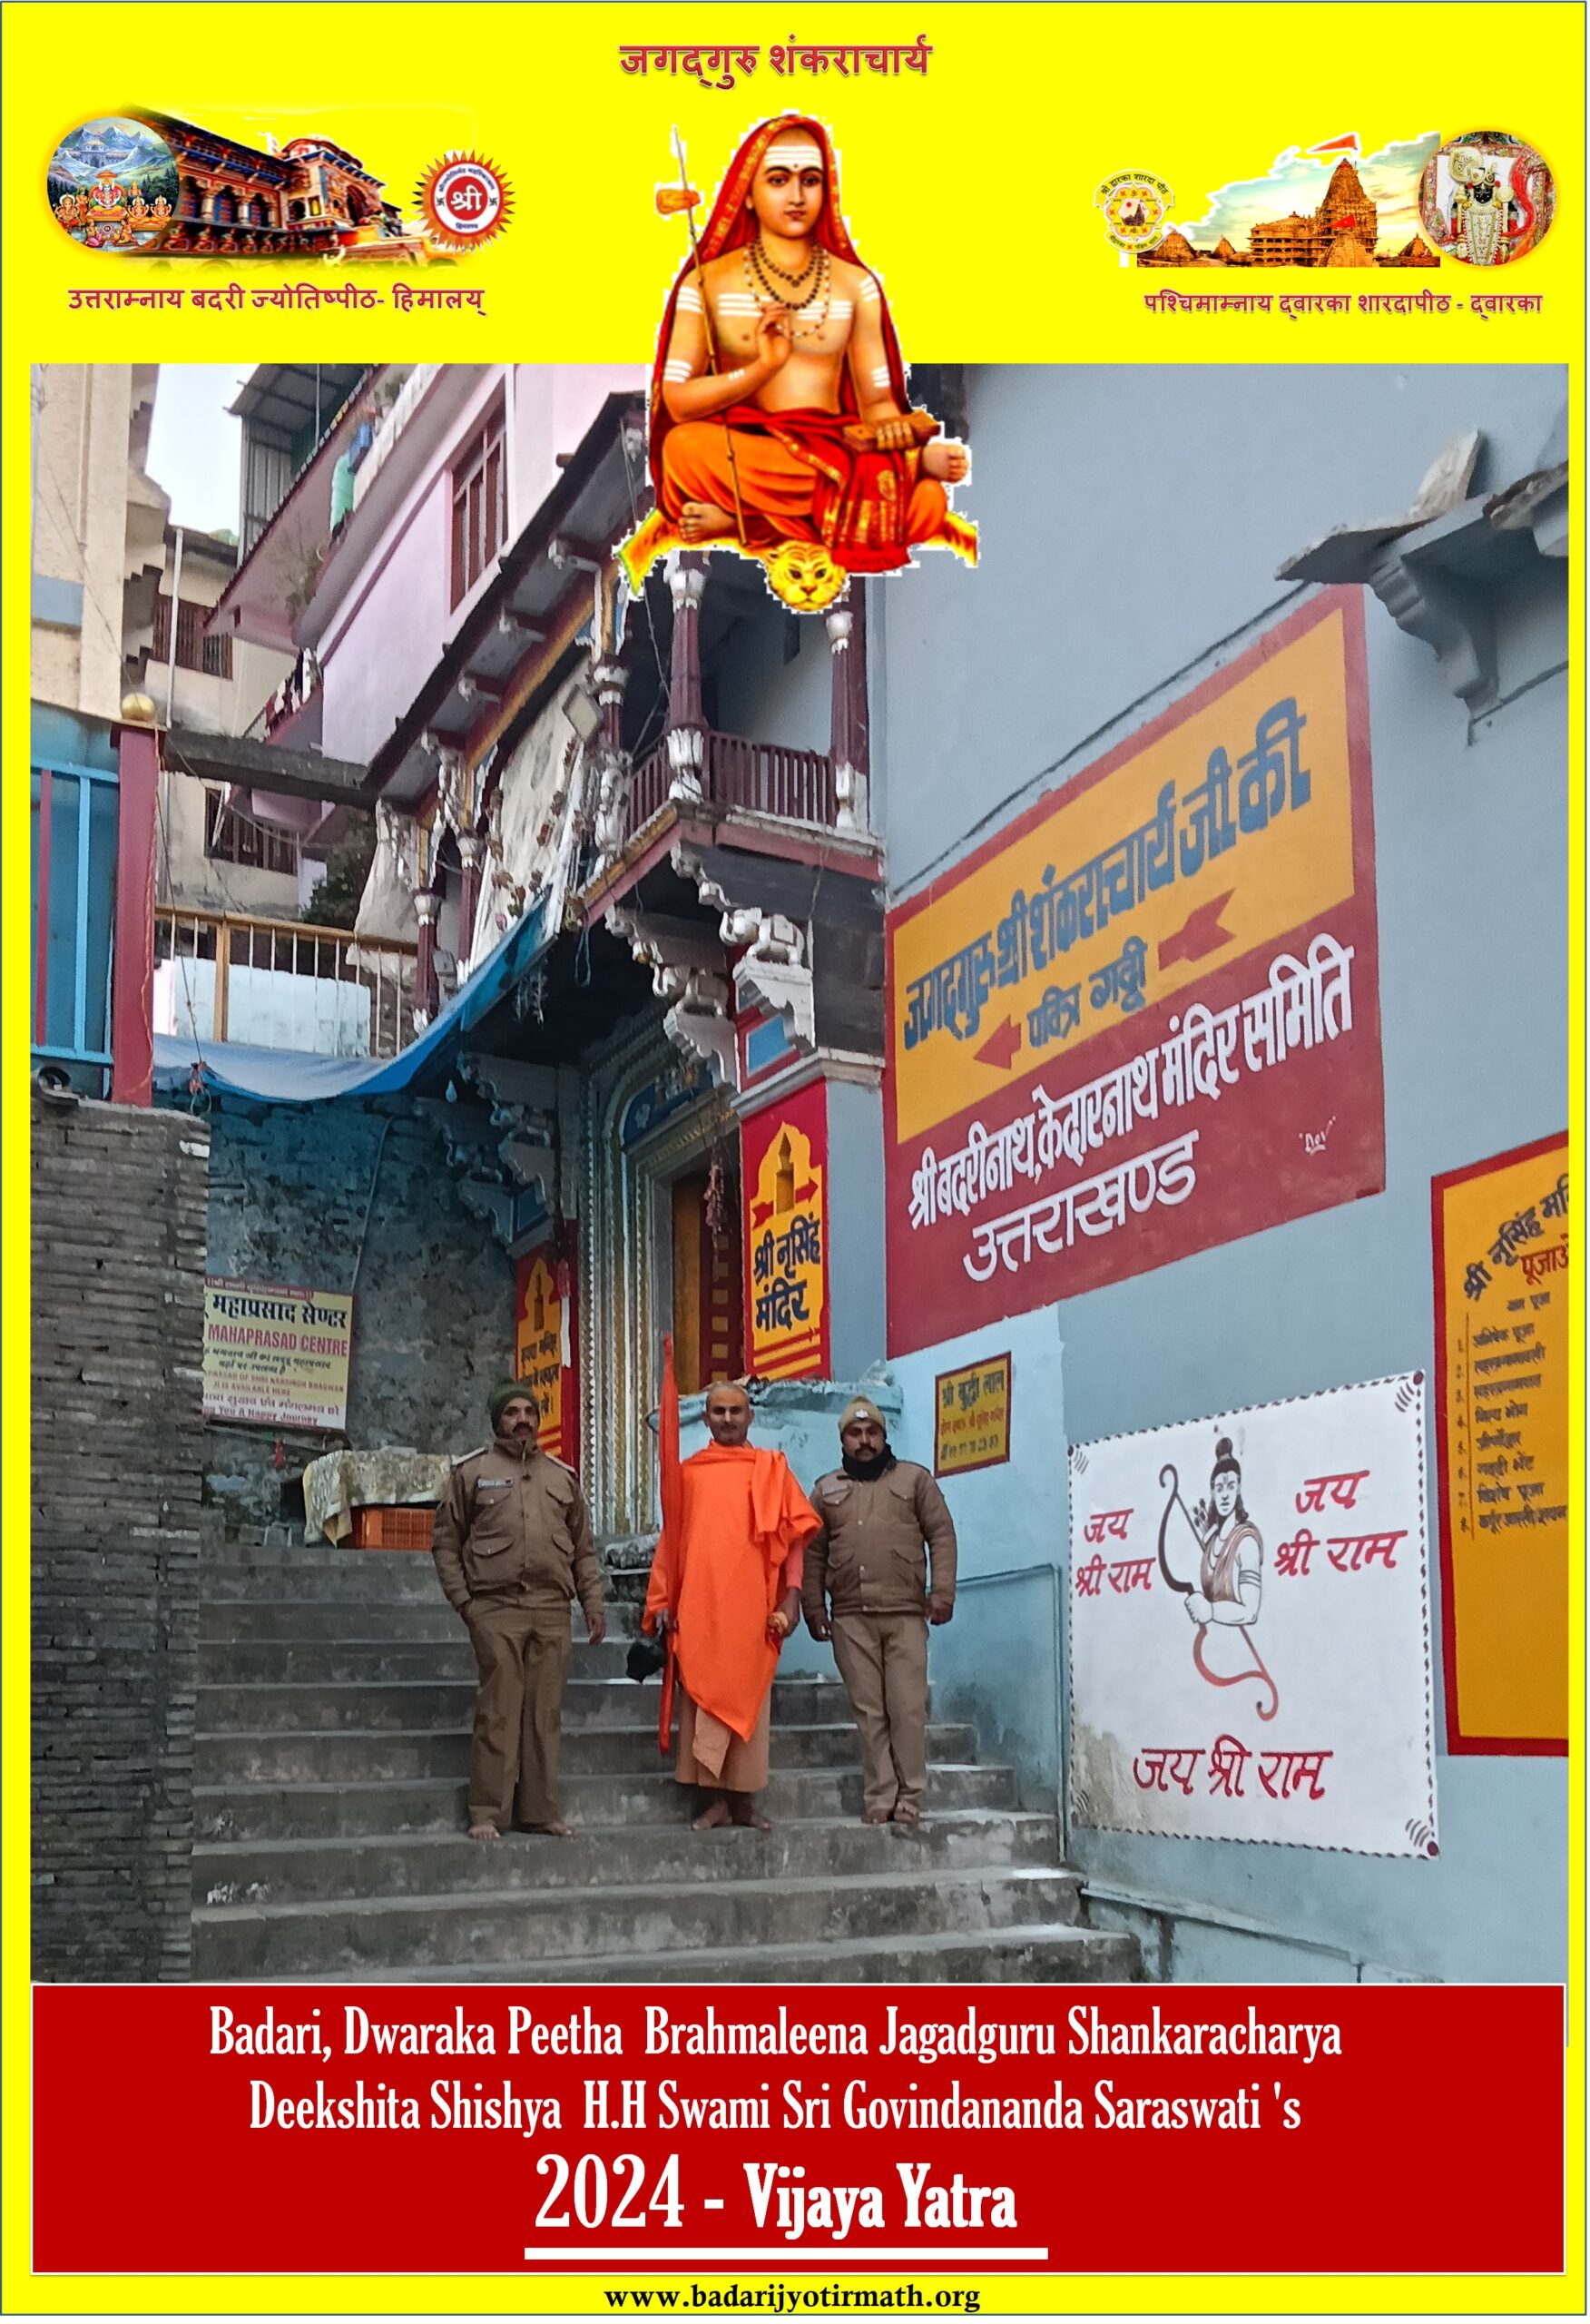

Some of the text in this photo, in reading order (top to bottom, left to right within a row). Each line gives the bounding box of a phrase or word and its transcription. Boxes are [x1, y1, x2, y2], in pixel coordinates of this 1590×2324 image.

[1179, 746, 1237, 878] जी
[1236, 696, 1312, 834] की
[908, 1146, 938, 1231] श्री
[1162, 1003, 1240, 1106] मंदिर
[1242, 932, 1355, 1072] समिति
[962, 1129, 1201, 1283] उत्तराखण्ड
[753, 1211, 821, 1285] श्री नृसिंह
[755, 1276, 810, 1333] मंदिर
[1464, 1260, 1493, 1303] श्री
[208, 1324, 298, 1351] MAHAPRASAD
[300, 1334, 348, 1358] CENTRE
[231, 1382, 270, 1393] AVAILABLE
[218, 1406, 236, 1417] You
[248, 1408, 278, 1422] Happy
[280, 1412, 318, 1425] Journey
[1295, 1469, 1371, 1514] जय
[1083, 1507, 1134, 1544] जय
[1075, 1553, 1157, 1598] श्री राम
[1273, 1529, 1408, 1577] श्री राम
[1133, 1733, 1334, 1801] जय श्री राम
